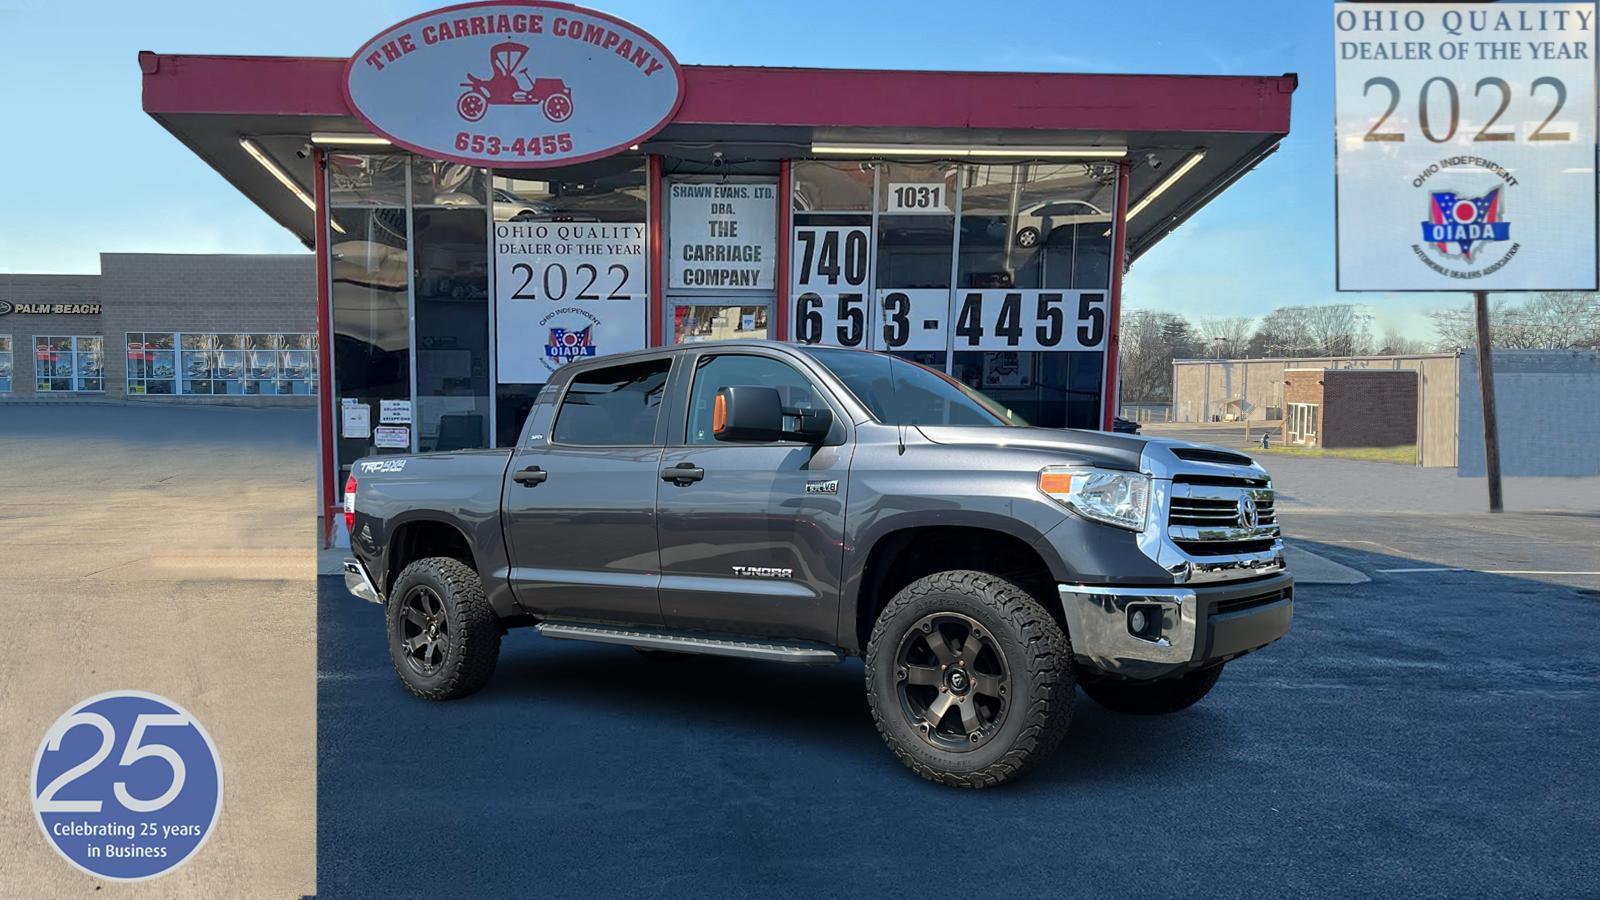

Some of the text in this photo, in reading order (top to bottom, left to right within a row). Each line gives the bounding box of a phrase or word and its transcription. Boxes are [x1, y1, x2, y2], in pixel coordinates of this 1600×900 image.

[1337, 10, 1593, 35] OHIO QUALITY
[365, 14, 664, 77] THE CARRIAGE COMPANY
[1340, 41, 1589, 60] DEALER OF THE YEAR
[1362, 76, 1571, 143] 2022
[455, 131, 573, 156] 653-4455
[1412, 156, 1519, 188] OHIO INDEPENDENT
[673, 186, 712, 198] SHAWN
[754, 187, 775, 199] LTD.
[894, 186, 940, 208] 1031
[711, 203, 736, 215] DBA.
[497, 226, 644, 241] OHIO QUALITY
[709, 220, 738, 238] THE
[1433, 224, 1495, 241] OIADA
[500, 243, 641, 255] DEALER OF THE YEAR
[683, 244, 762, 262] CARRIAGE
[797, 230, 868, 286] 740
[510, 263, 632, 301] 2022
[683, 268, 761, 286] COMPANY
[1450, 269, 1482, 280] DEALERS
[14, 303, 100, 314] PALM BEACH
[539, 307, 601, 326] OHIO INDEPENDENT
[551, 346, 588, 356] OIADA
[361, 461, 385, 473] TRD
[732, 566, 792, 578] TUNDRA
